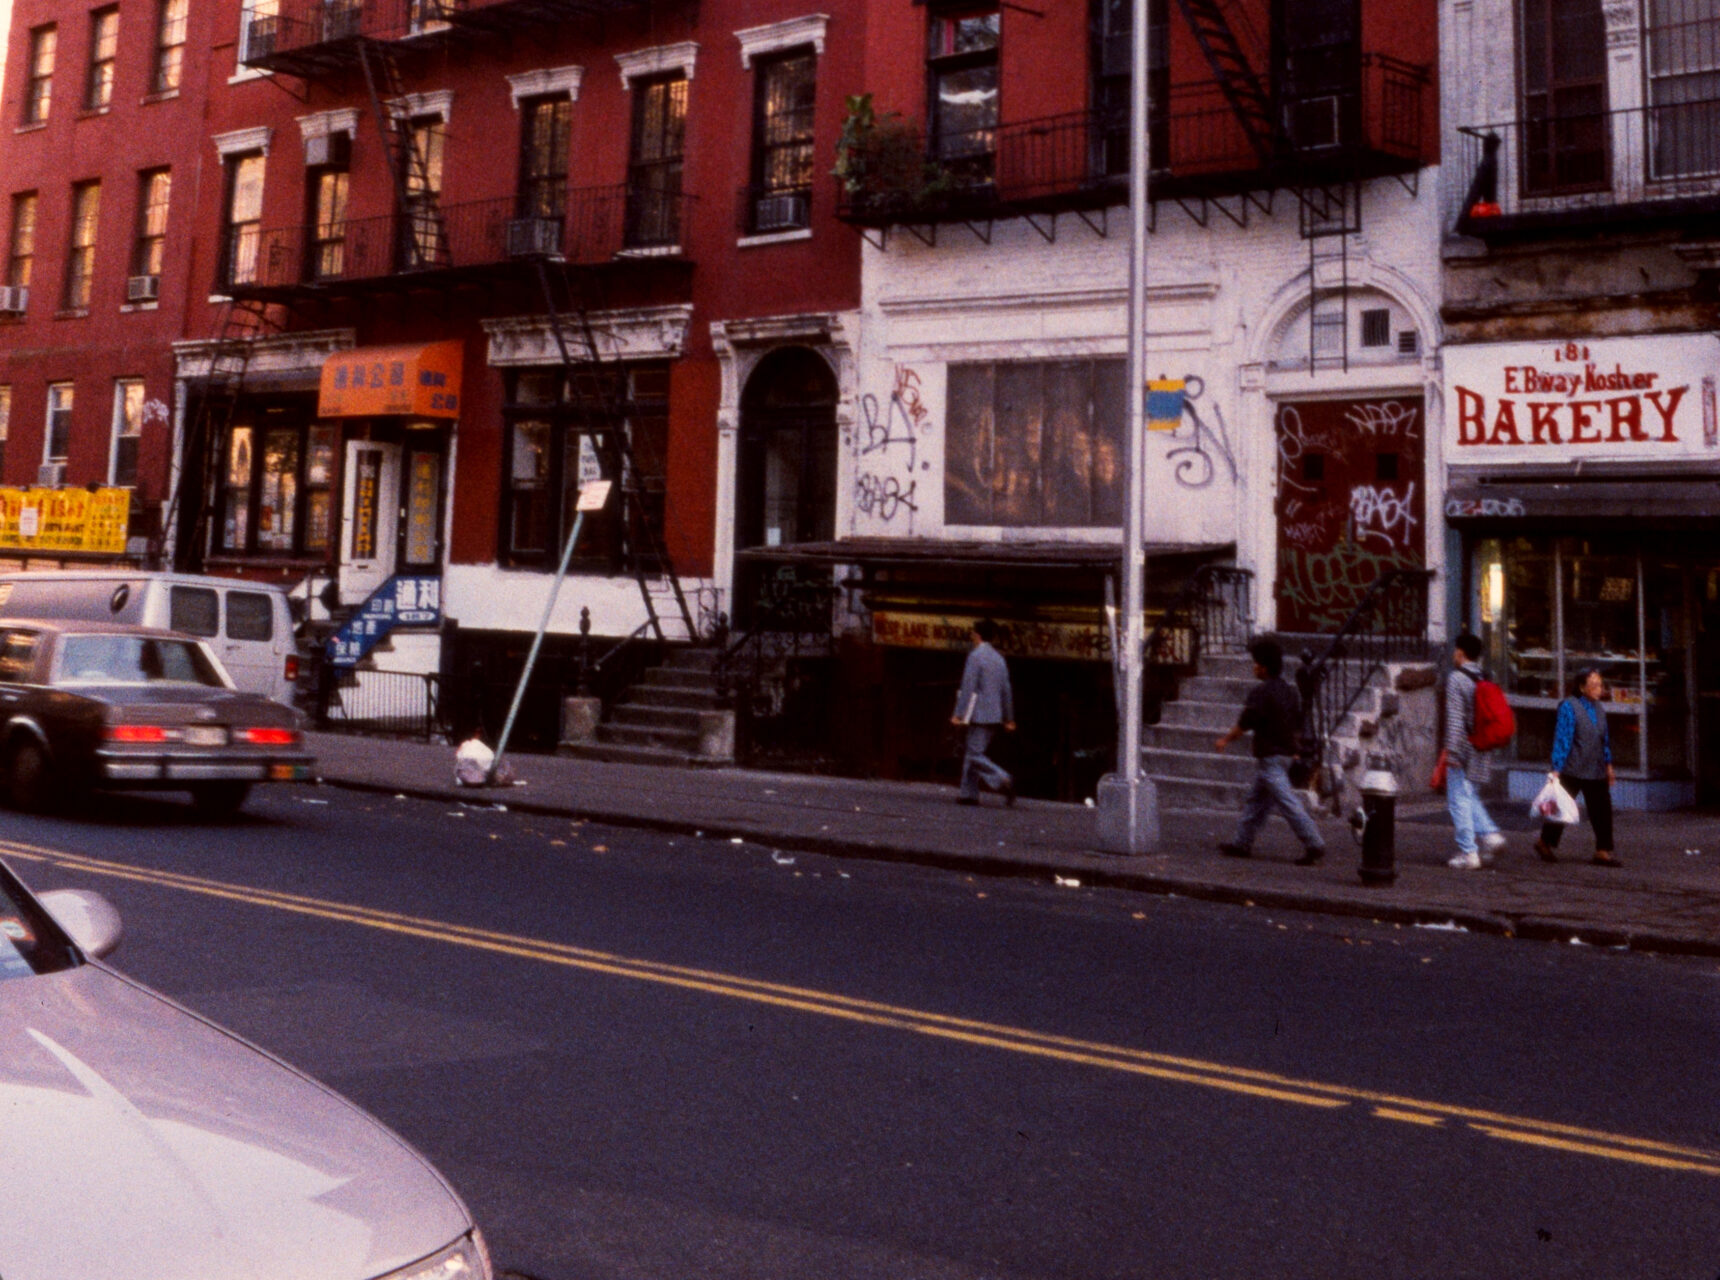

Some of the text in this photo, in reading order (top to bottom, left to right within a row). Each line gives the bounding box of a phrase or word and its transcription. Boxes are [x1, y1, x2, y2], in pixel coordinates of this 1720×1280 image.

[1554, 341, 1590, 362] 181
[1504, 366, 1521, 393] E
[1584, 362, 1659, 393] Kosher
[1455, 384, 1690, 446] BAKERY
